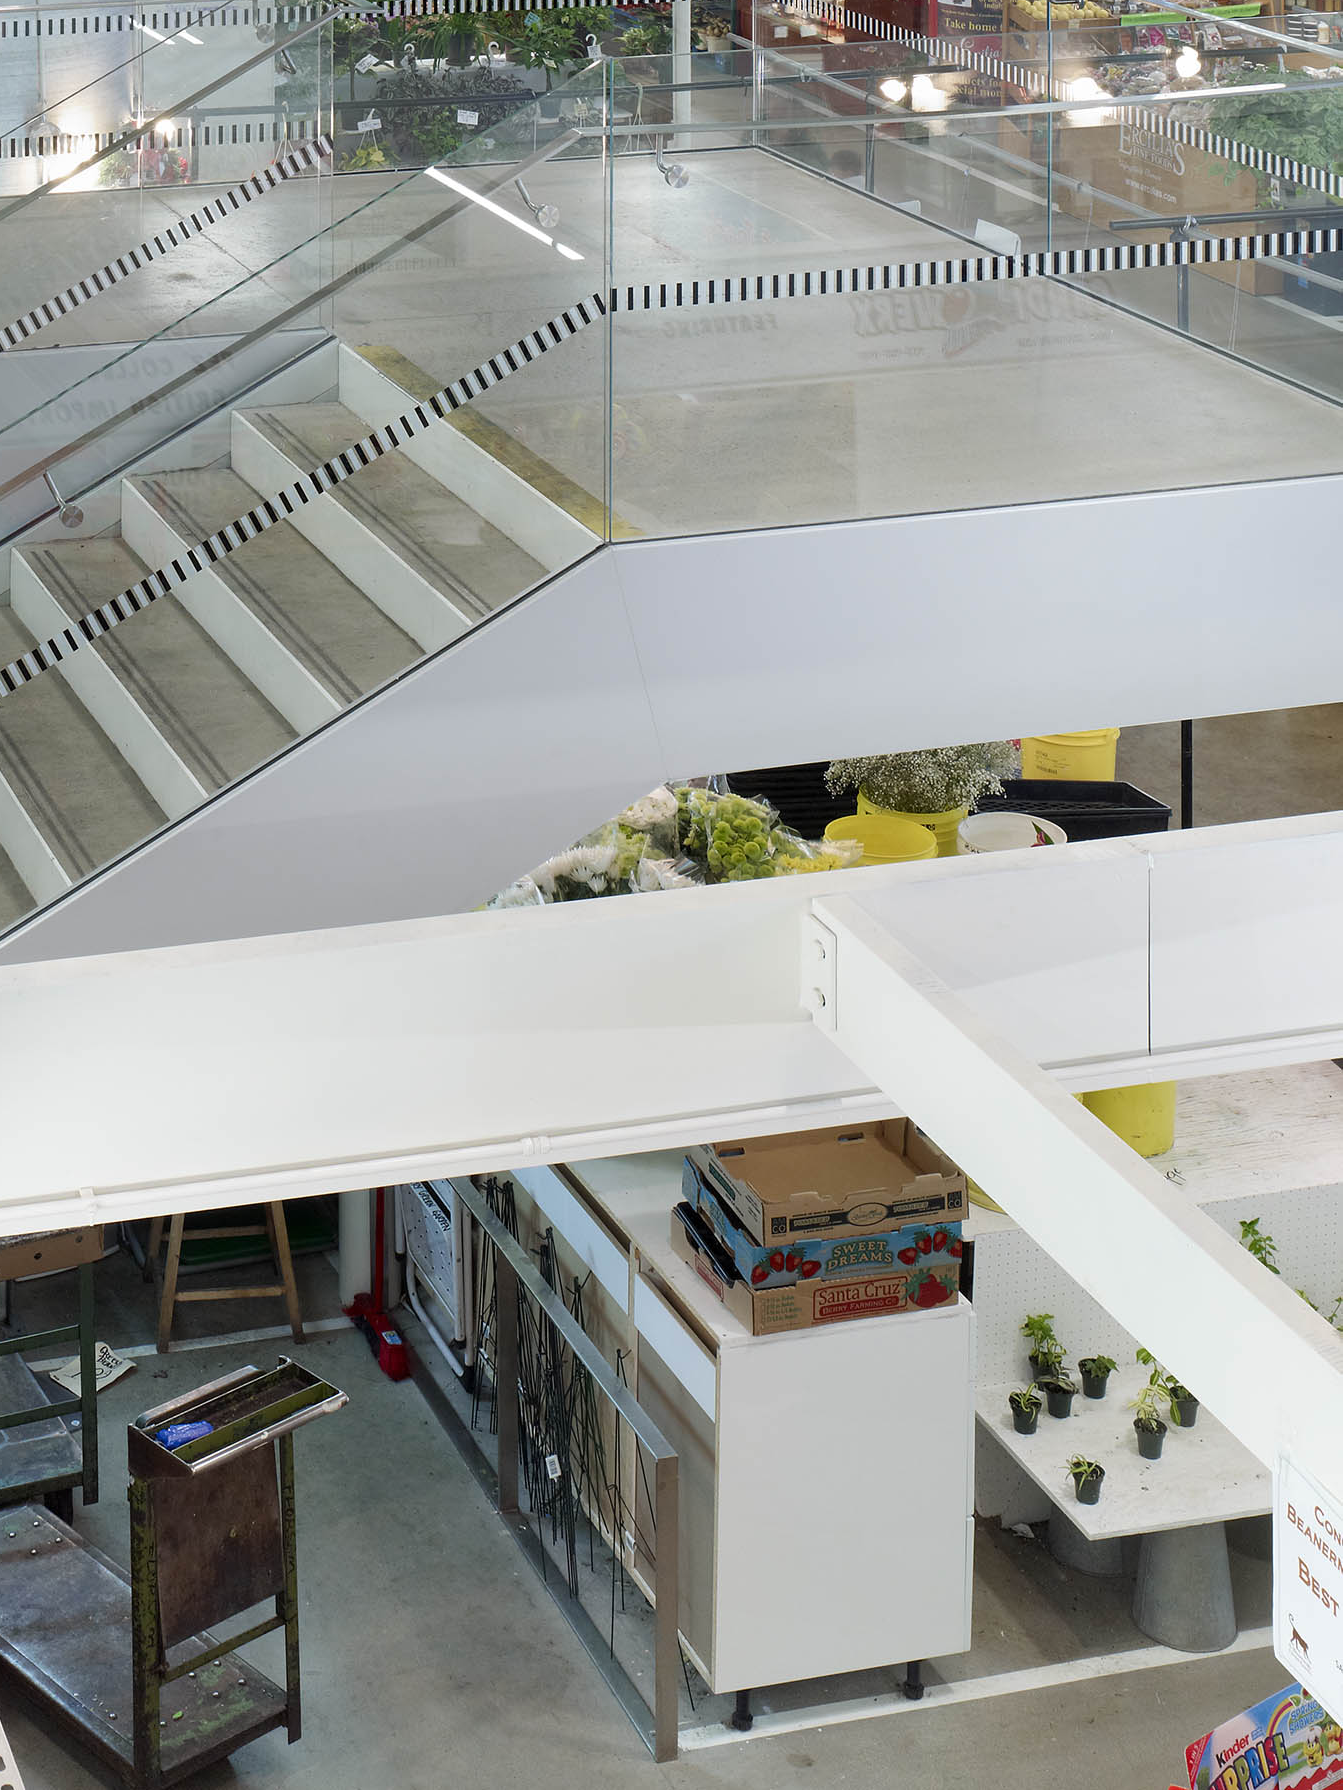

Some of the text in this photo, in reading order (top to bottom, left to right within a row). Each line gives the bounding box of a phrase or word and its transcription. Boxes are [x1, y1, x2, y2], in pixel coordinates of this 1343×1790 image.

[944, 17, 995, 32] Take home
[833, 1240, 887, 1258] SWEET
[827, 1252, 893, 1270] DREAMS
[818, 1282, 901, 1306] Santa Cruz
[822, 1304, 848, 1315] BERRY
[850, 1300, 884, 1312] FARMING
[1298, 1556, 1340, 1618] BEST
[1291, 1699, 1319, 1721] SPRING
[1290, 1707, 1326, 1736] SHOWERS
[1215, 1733, 1250, 1769] Kinder
